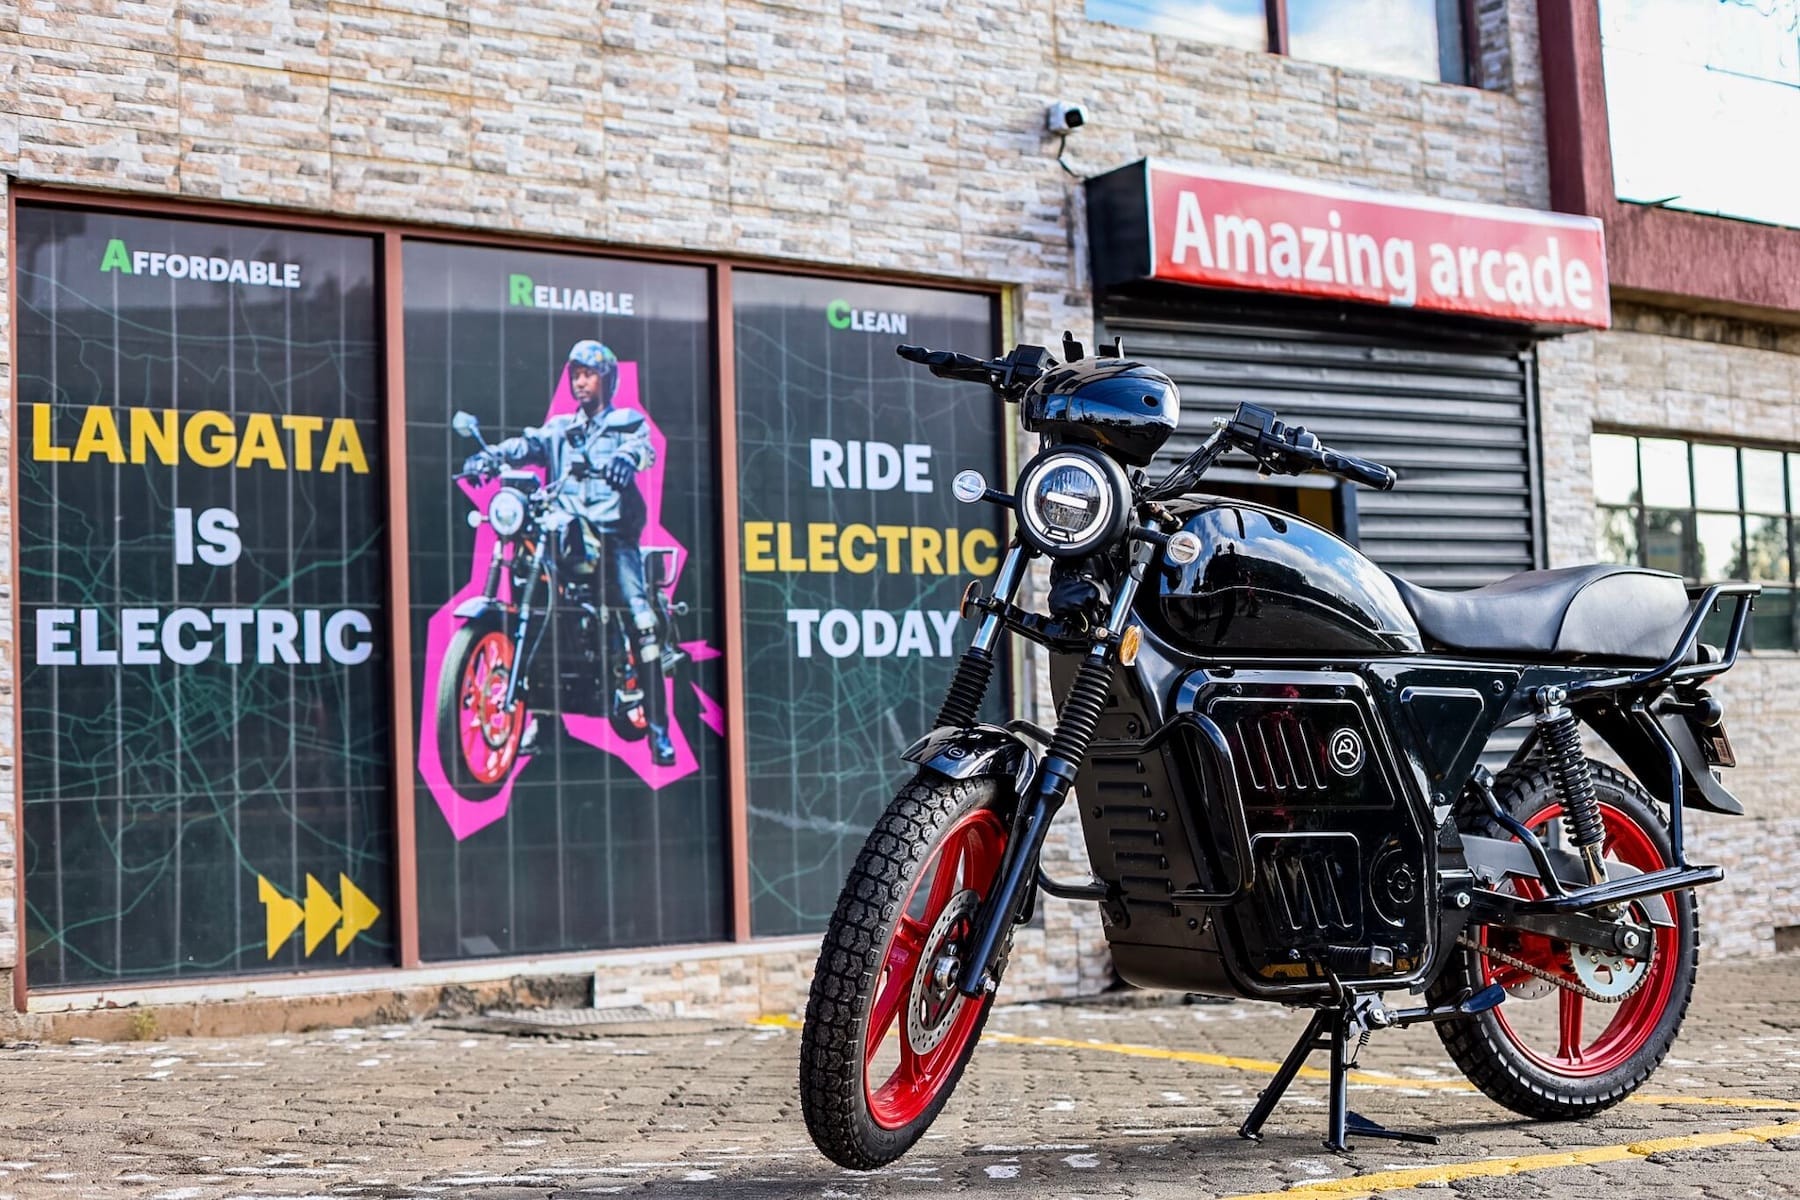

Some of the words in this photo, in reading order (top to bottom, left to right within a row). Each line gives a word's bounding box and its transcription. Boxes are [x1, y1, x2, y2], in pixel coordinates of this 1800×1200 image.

[101, 239, 301, 287] AFFORDABLE
[1171, 190, 1416, 306] Amazing
[1430, 237, 1593, 310] arcade
[509, 273, 634, 315] RELIABLE
[826, 299, 907, 335] CLEAN
[32, 403, 370, 473] LANGATA
[810, 438, 933, 492] RIDE
[174, 507, 242, 566] IS
[744, 521, 998, 577] ELECTRIC
[36, 608, 373, 666] ELECTRIC
[787, 608, 960, 658] TODAY
